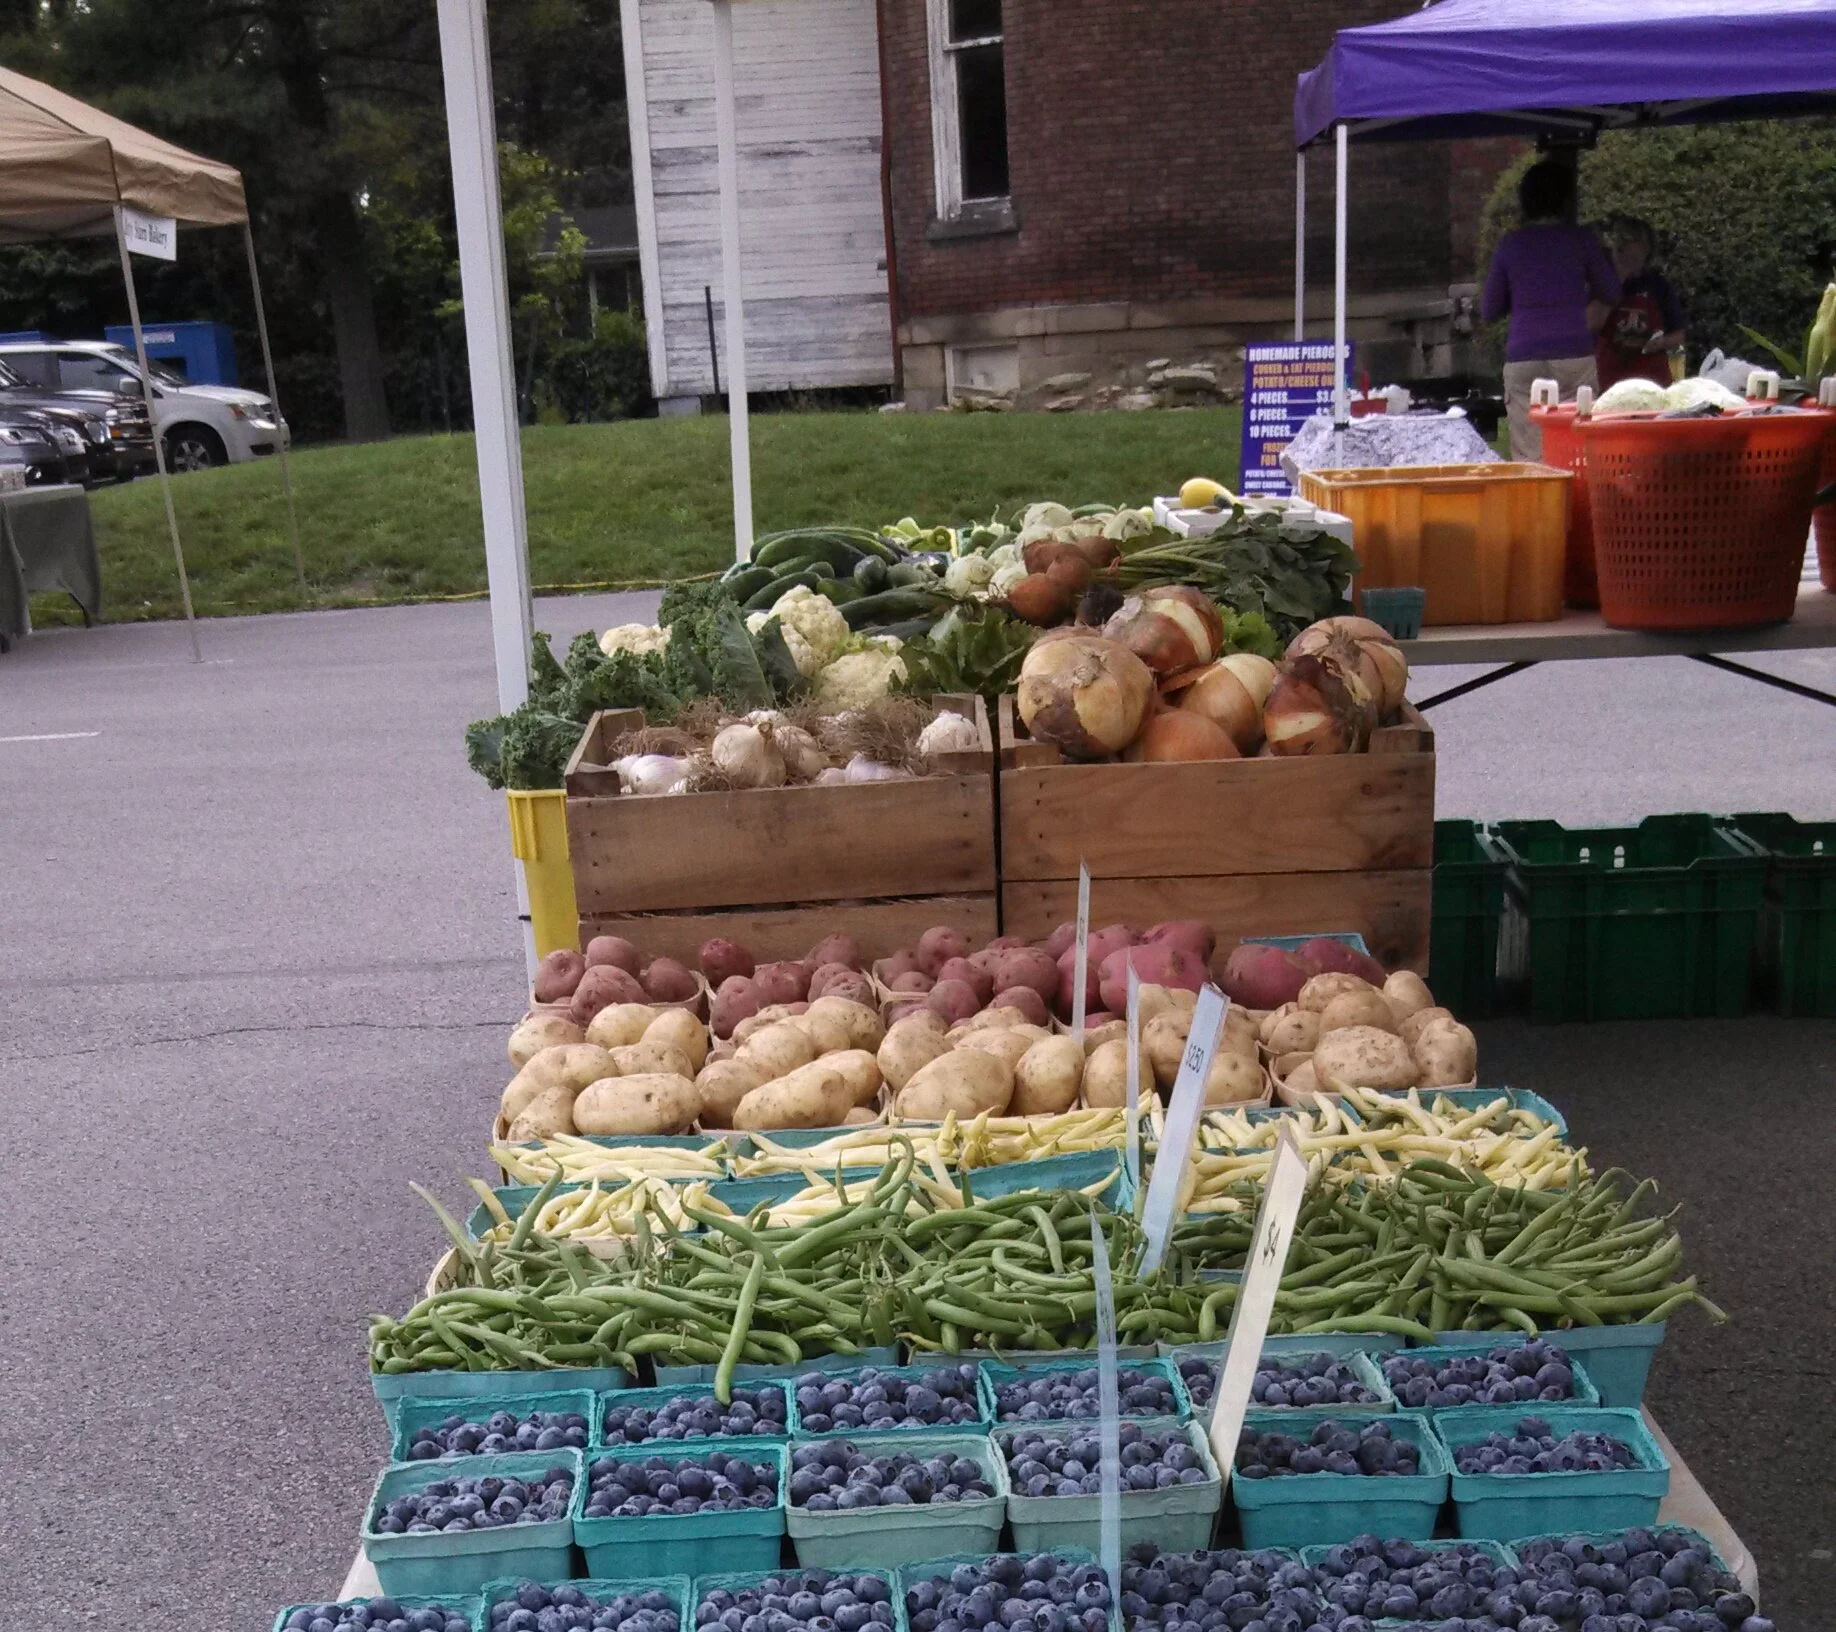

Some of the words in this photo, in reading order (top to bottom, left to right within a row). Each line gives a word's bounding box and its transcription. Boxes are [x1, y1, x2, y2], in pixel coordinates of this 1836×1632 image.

[1249, 347, 1300, 362] HOMEMADE
[1301, 345, 1350, 360] PIEROGS
[1253, 363, 1282, 375] COOKED
[1250, 392, 1257, 405] 4
[1249, 425, 1260, 438] 10
[1262, 1213, 1281, 1267] $4
